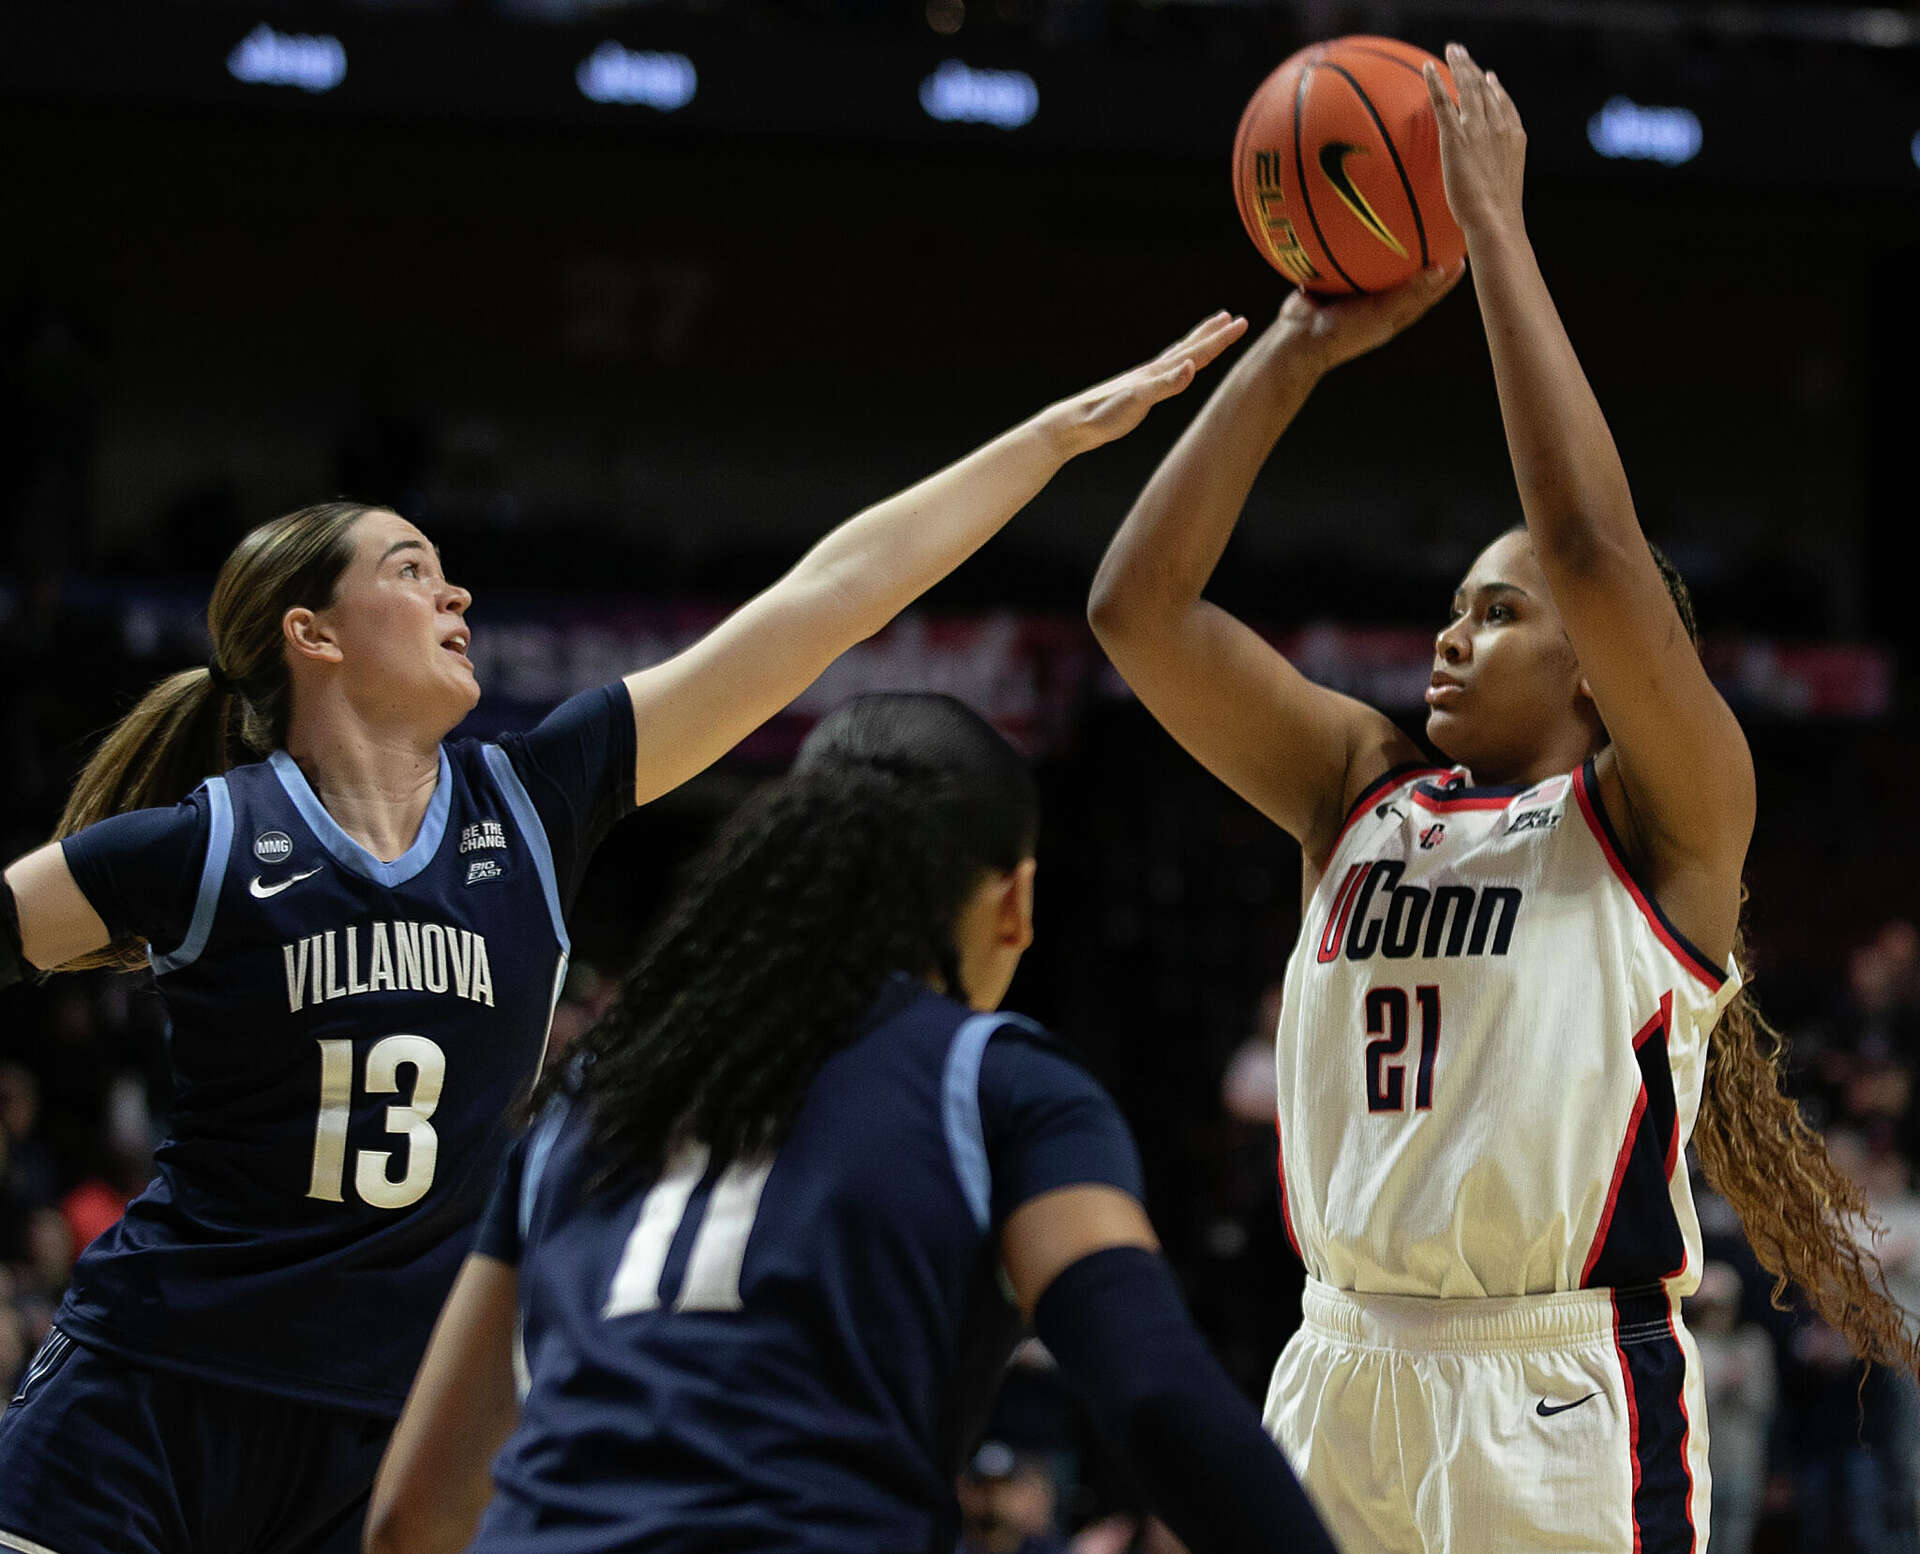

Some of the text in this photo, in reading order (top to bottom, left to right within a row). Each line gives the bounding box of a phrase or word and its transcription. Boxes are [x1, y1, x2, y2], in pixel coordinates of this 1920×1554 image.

[258, 840, 289, 854] MMG
[460, 835, 507, 854] CHANGE
[462, 822, 503, 841] BE THE
[468, 869, 502, 880] EAST
[471, 861, 496, 872] BIG
[1317, 859, 1523, 963] UConn
[282, 920, 495, 1013] VILLANOVA
[1365, 985, 1441, 1114] 21
[305, 1034, 446, 1210] 13
[602, 1142, 775, 1320] 11
